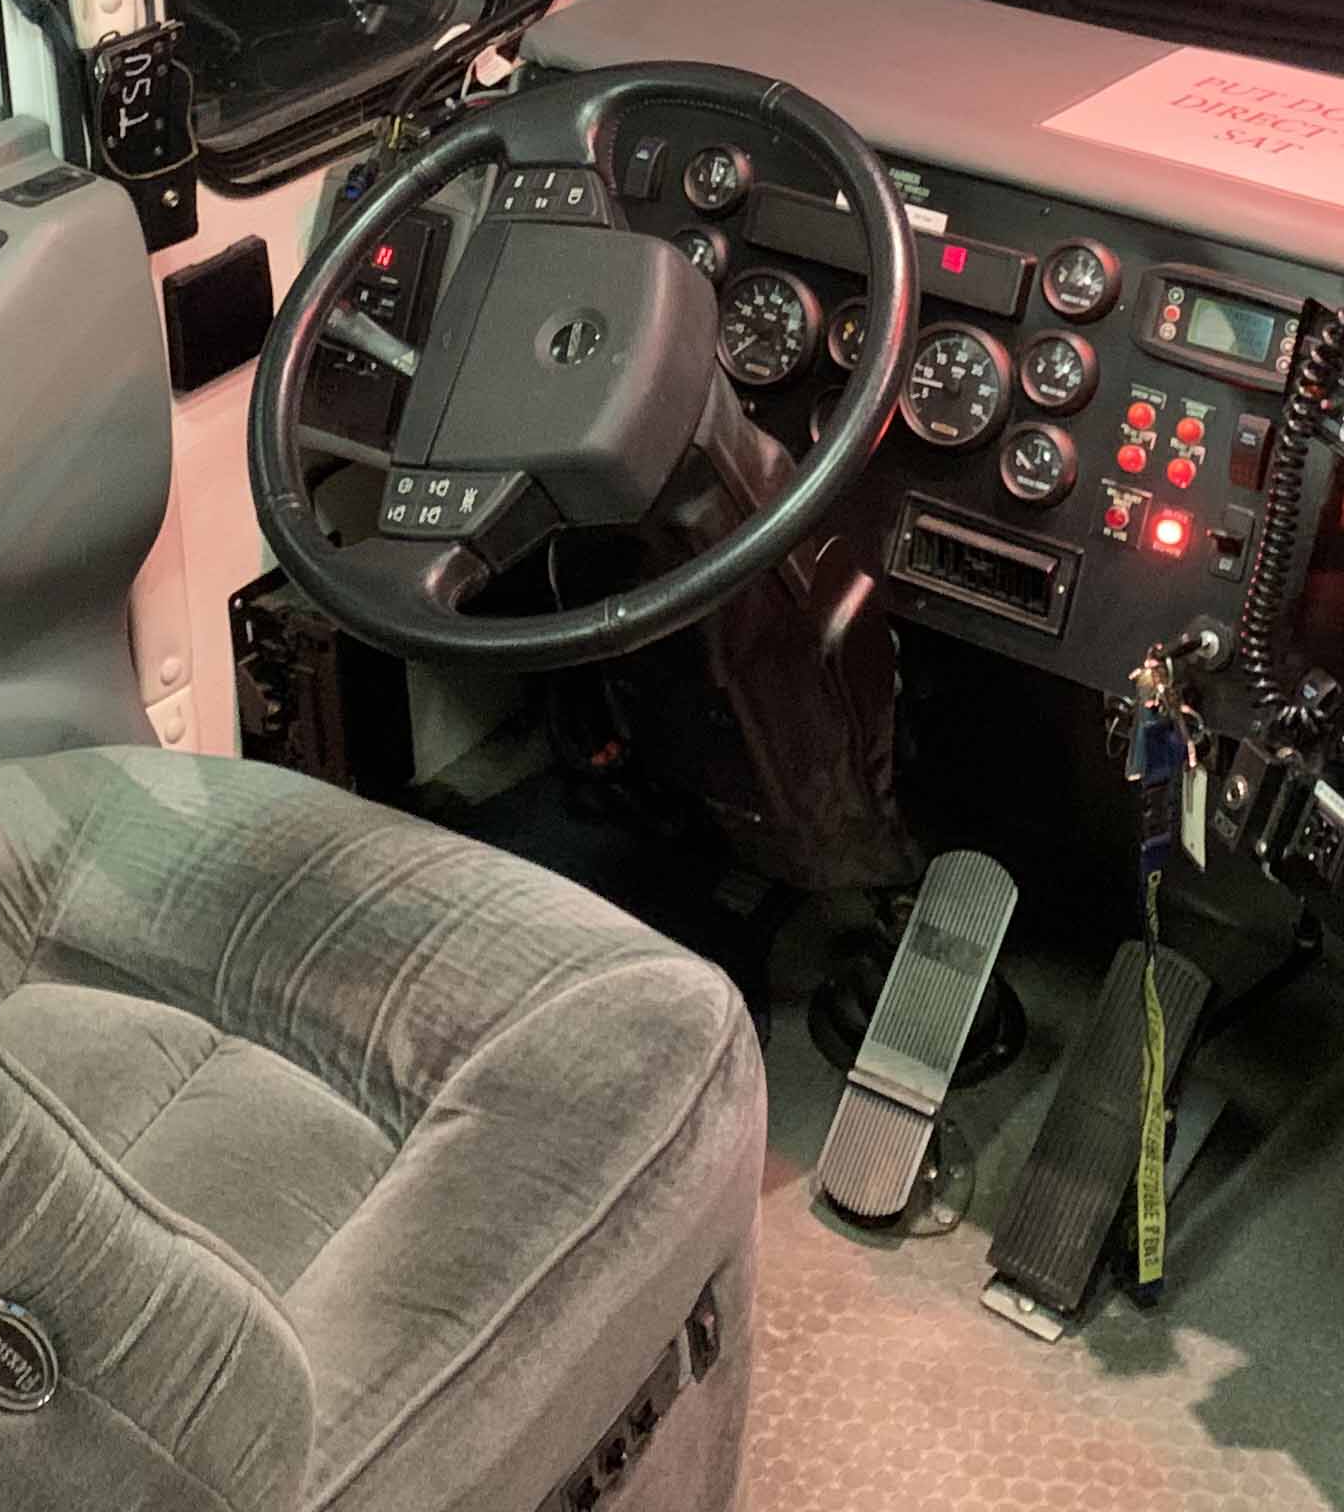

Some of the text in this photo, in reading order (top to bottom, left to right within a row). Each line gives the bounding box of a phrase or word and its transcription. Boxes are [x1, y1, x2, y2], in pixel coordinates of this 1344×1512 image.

[1194, 76, 1281, 102] PUT
[1170, 94, 1341, 140] DIRECT
[1213, 128, 1306, 156] SAT
